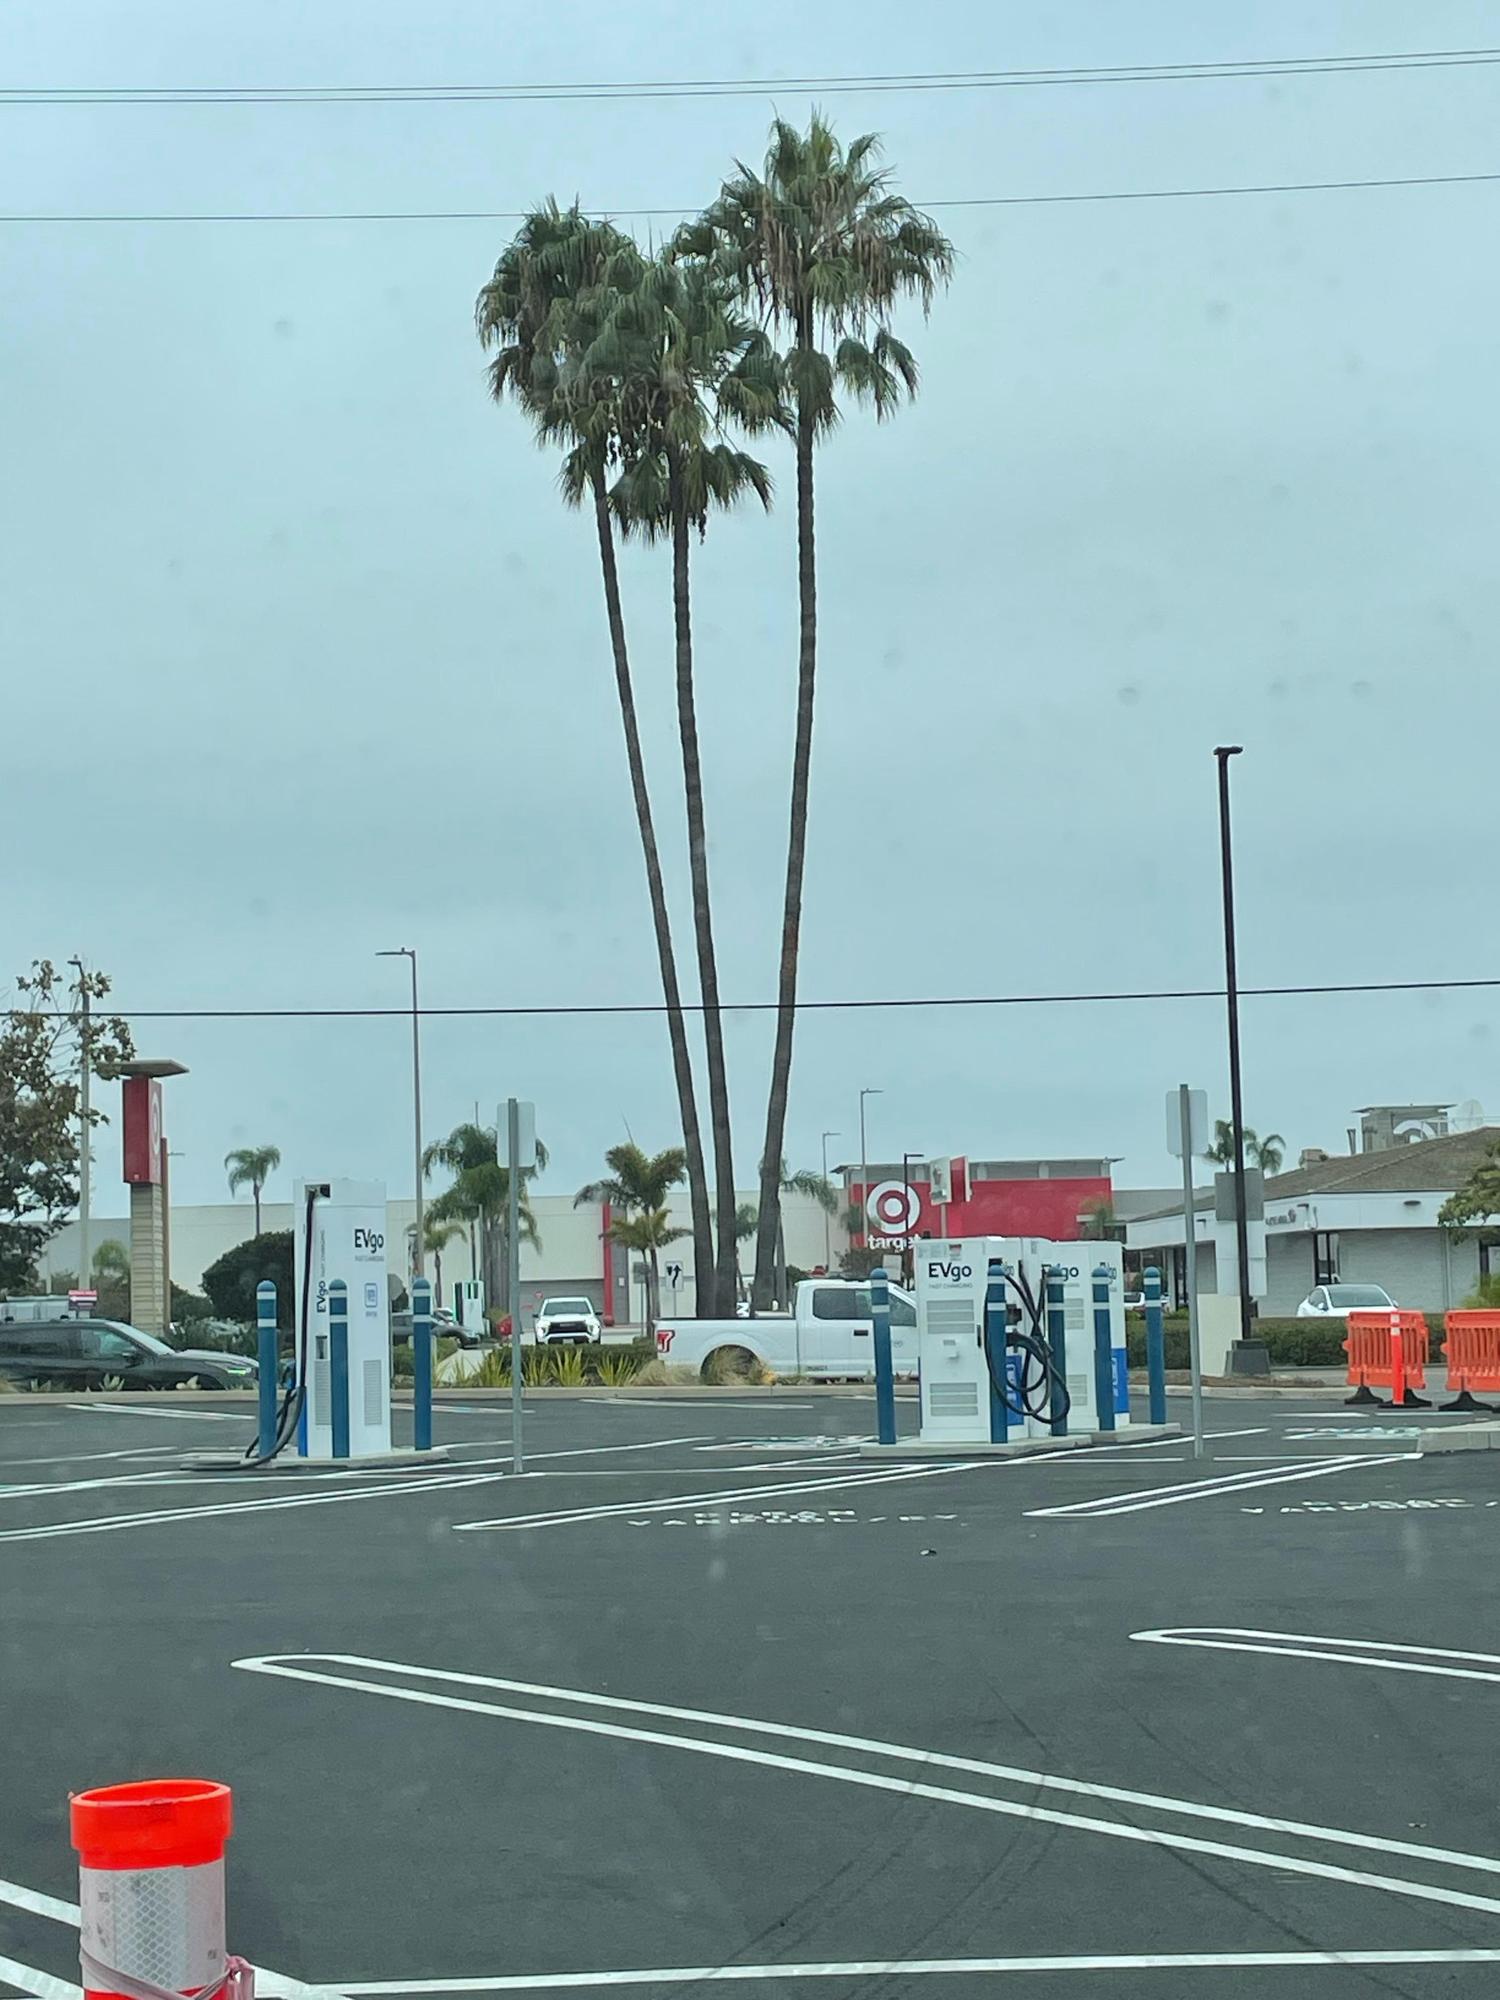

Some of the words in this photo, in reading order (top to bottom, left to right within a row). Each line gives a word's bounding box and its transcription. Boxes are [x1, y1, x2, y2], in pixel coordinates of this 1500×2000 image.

[354, 1229, 384, 1254] EVgo
[929, 1262, 972, 1282] EVgo
[316, 1280, 327, 1313] EVgo
